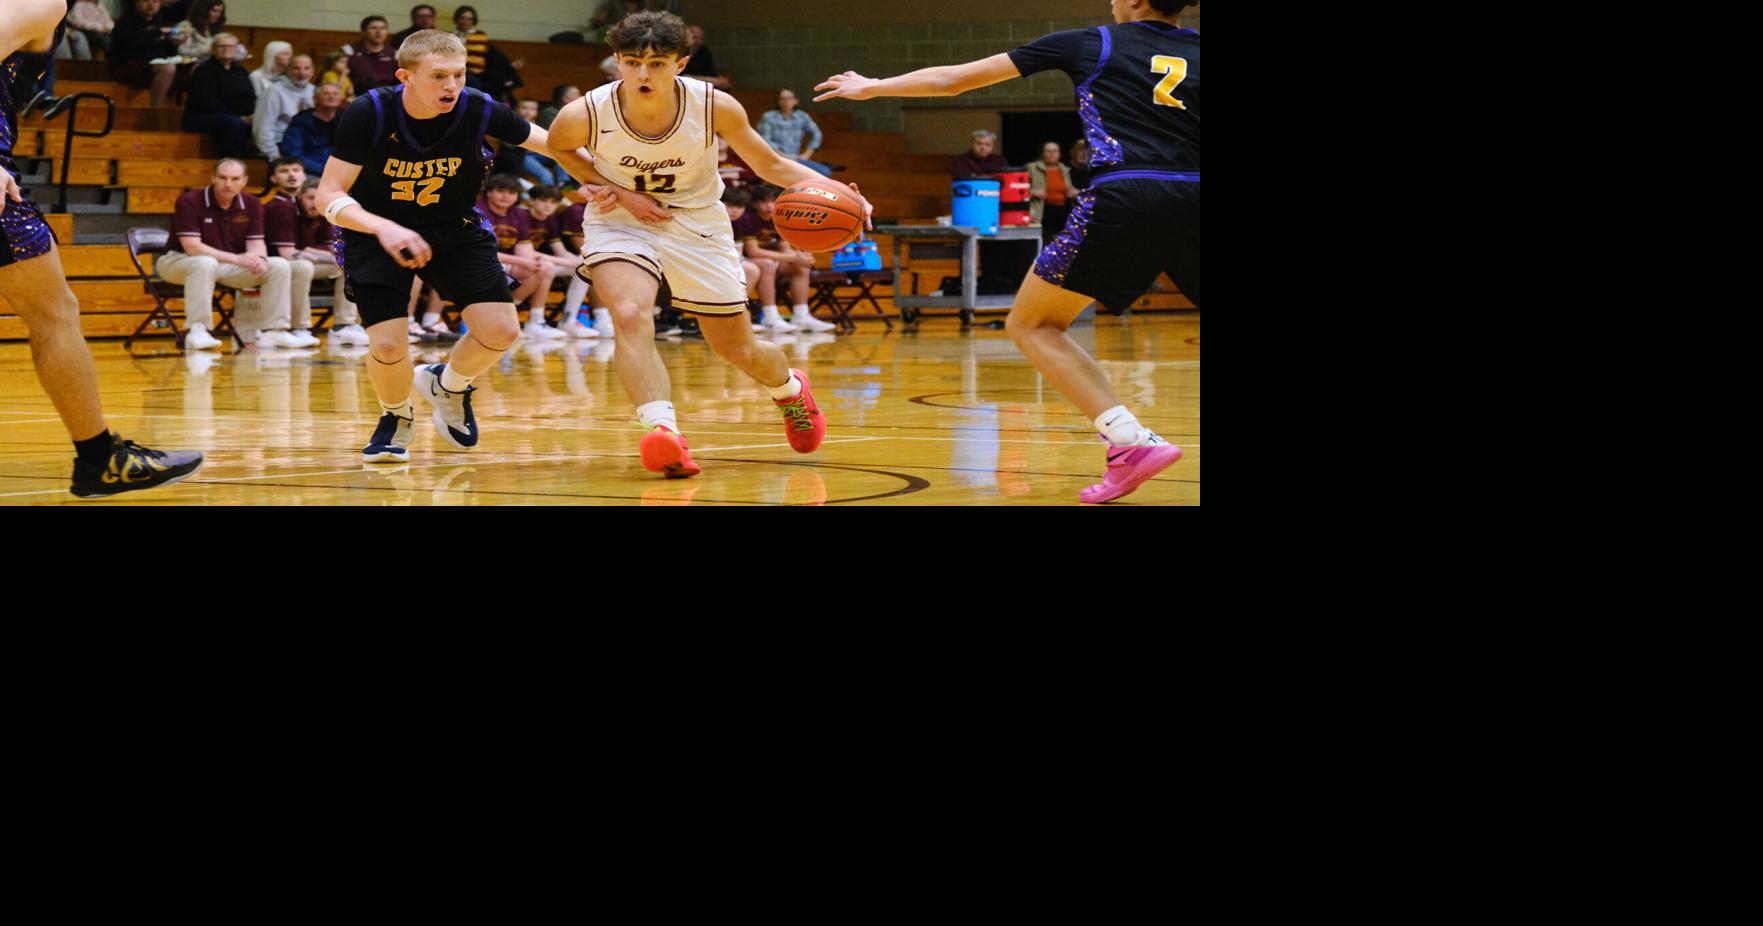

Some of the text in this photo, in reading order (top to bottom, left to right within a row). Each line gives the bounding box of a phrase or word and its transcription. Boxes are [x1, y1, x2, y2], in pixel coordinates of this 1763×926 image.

[1151, 55, 1187, 110] 2
[383, 157, 462, 179] CUSTER
[619, 155, 686, 173] Diggers
[390, 176, 446, 207] 32
[634, 174, 676, 193] 12
